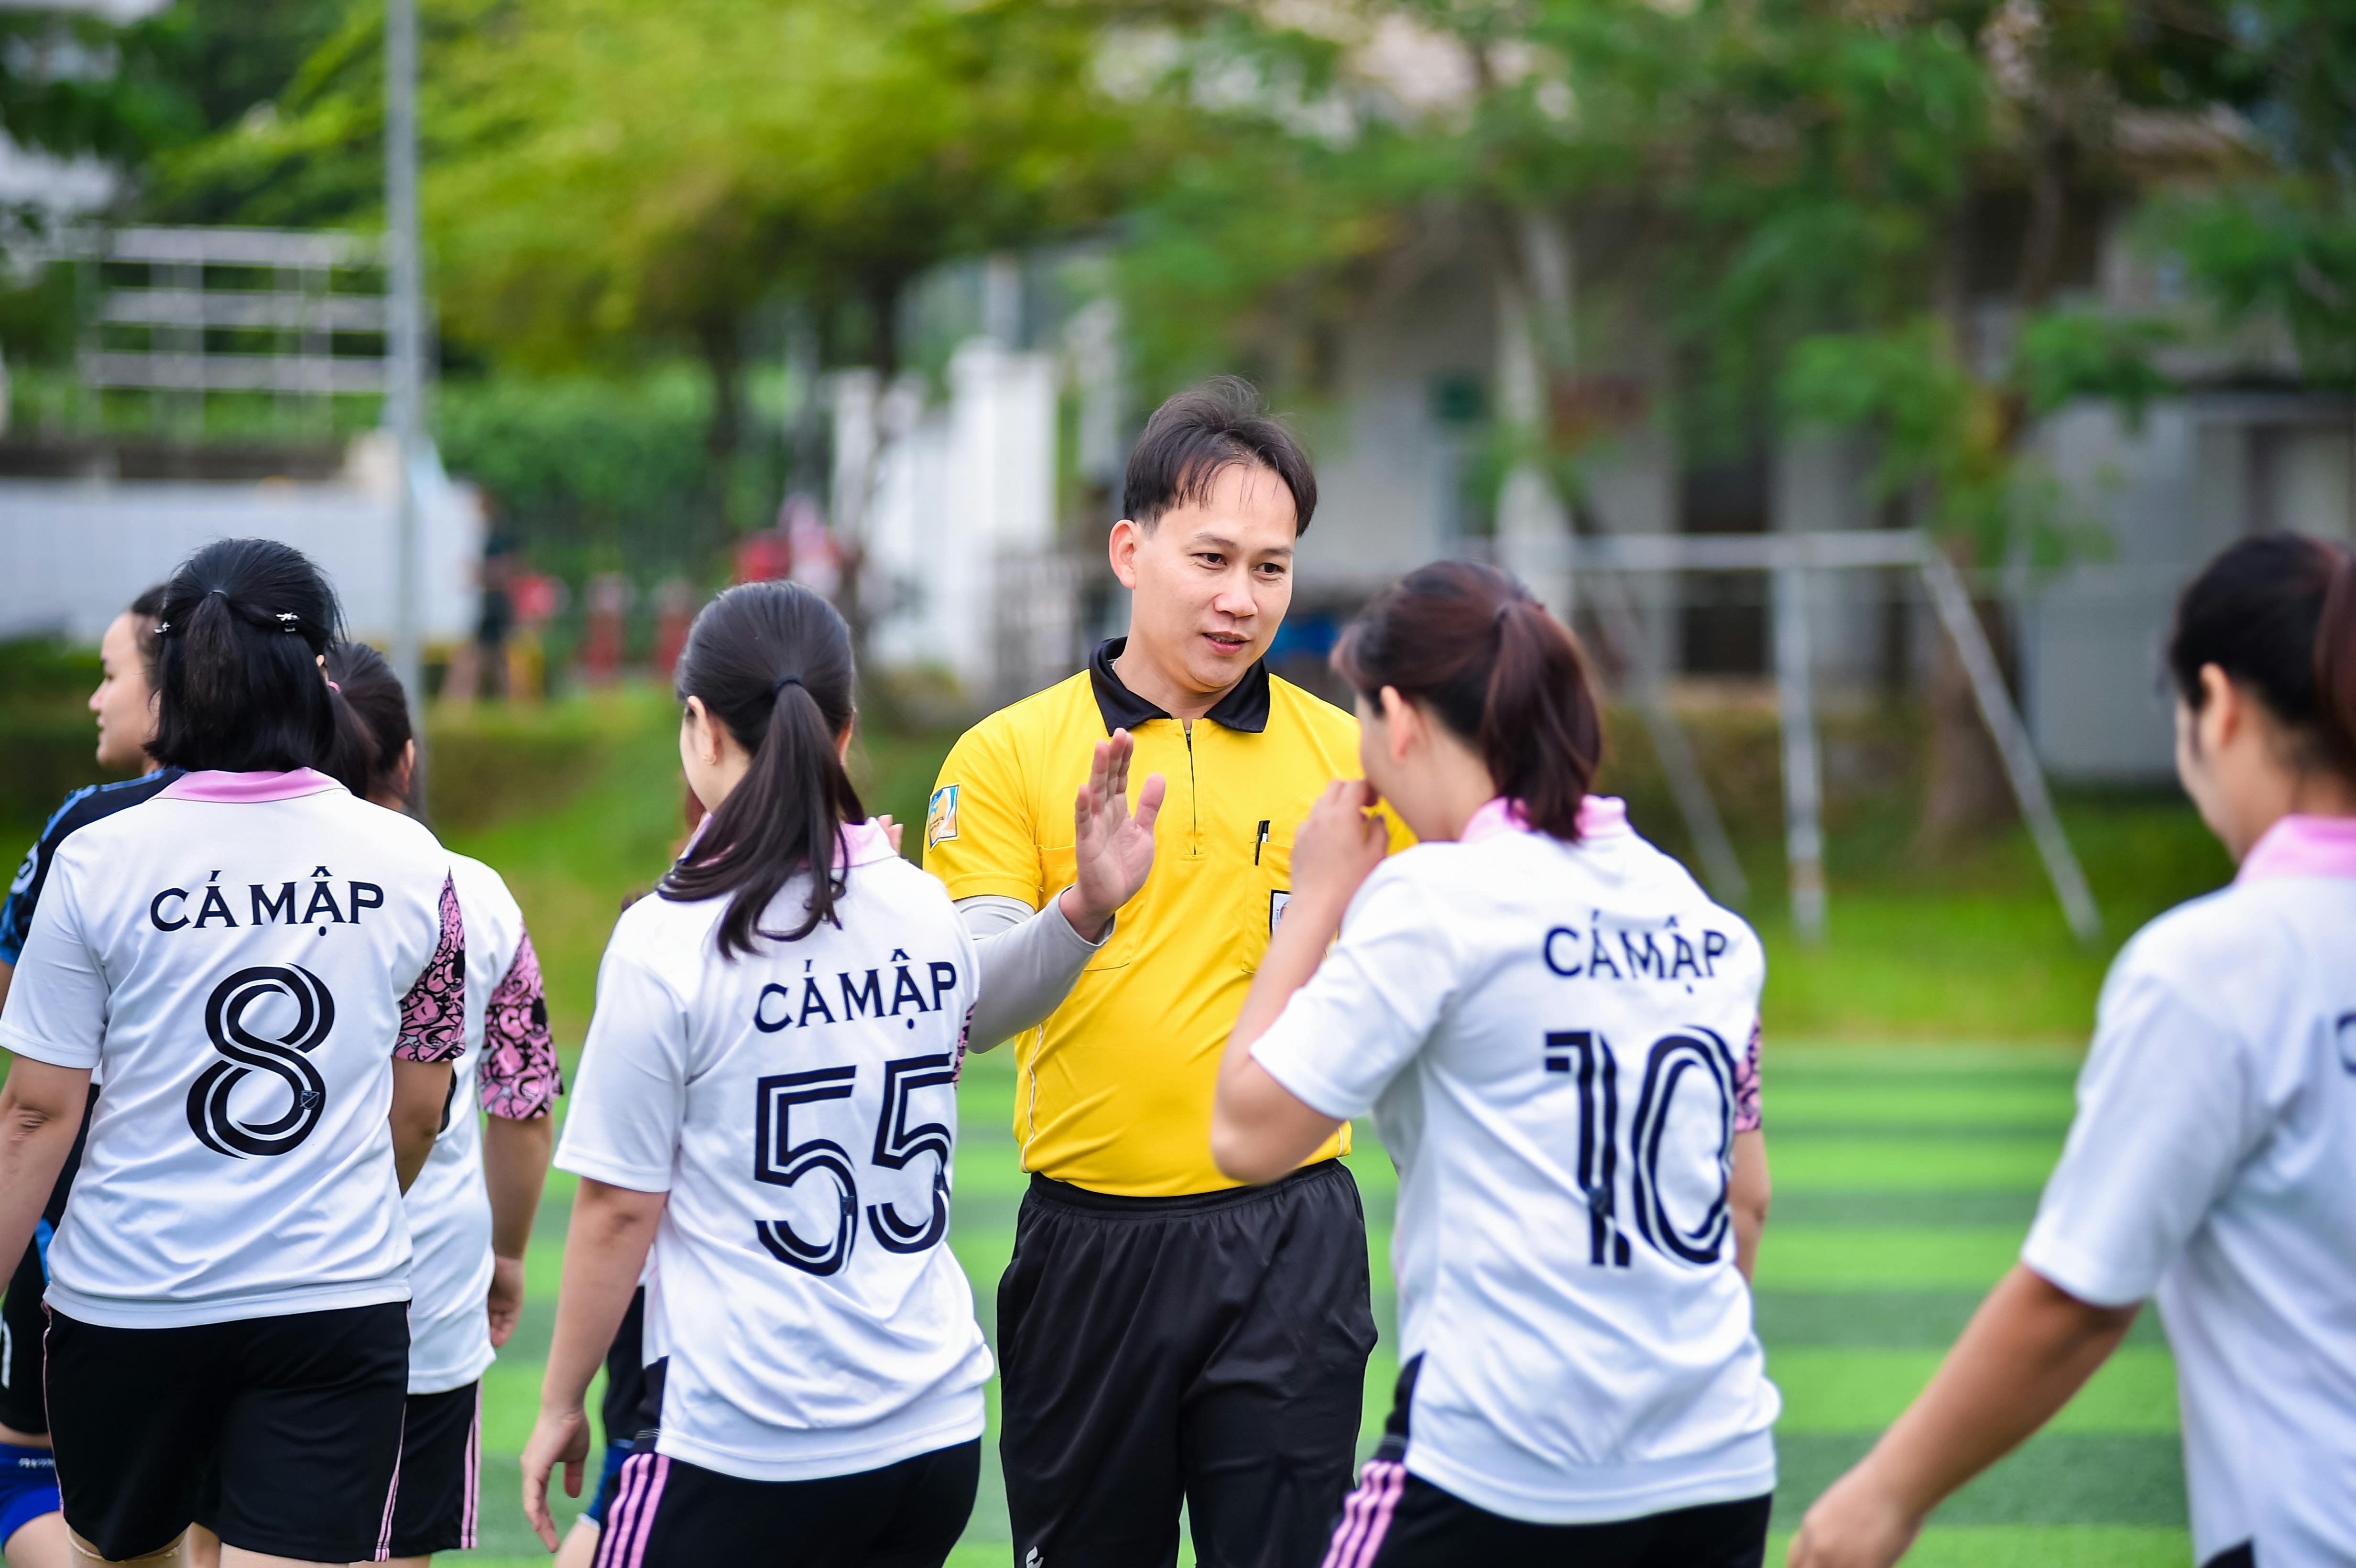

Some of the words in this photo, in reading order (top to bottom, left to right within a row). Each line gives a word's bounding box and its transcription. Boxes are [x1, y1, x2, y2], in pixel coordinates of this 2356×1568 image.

[150, 870, 240, 932] CÁ
[248, 866, 384, 936] MẬP
[185, 962, 335, 1160] 8
[753, 1051, 955, 1278] 55
[1543, 1025, 1738, 1269] 10
